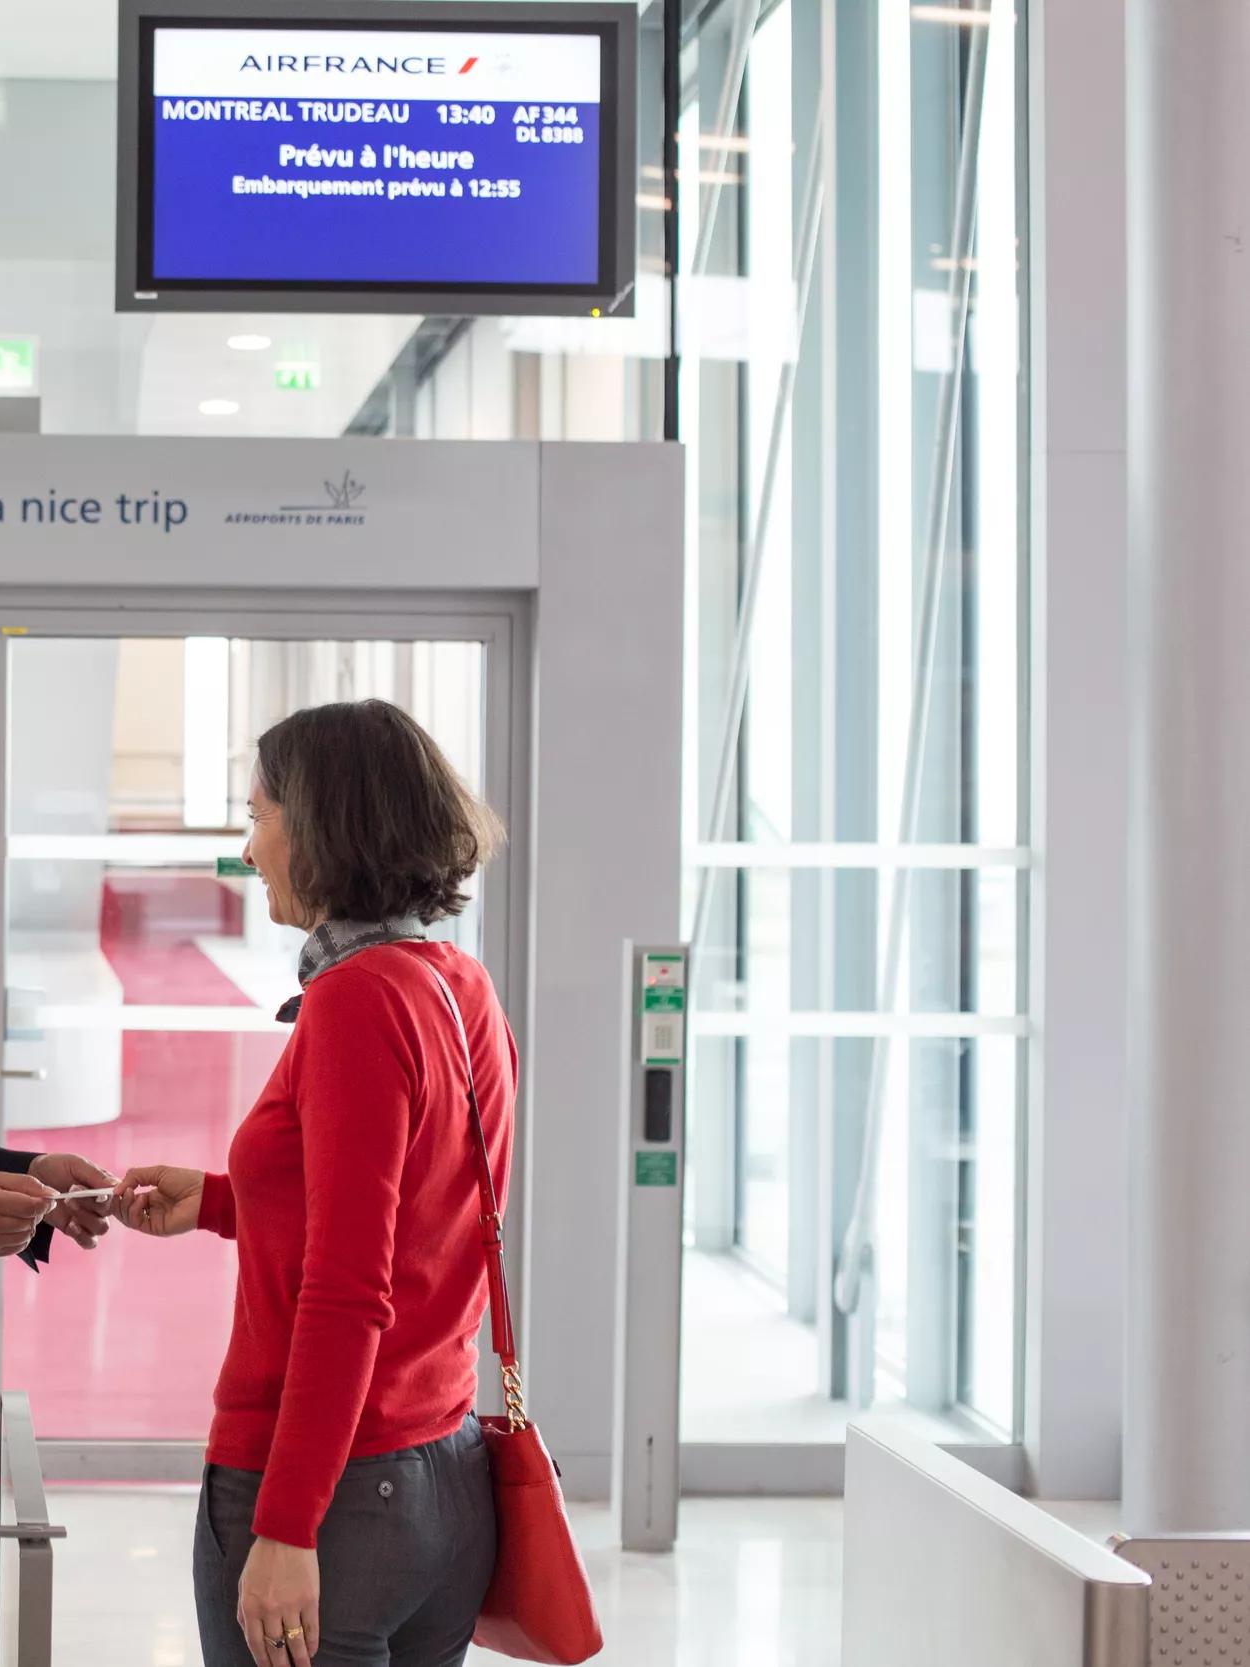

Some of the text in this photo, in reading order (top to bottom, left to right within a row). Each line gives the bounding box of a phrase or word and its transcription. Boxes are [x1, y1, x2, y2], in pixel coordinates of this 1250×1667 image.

[240, 55, 446, 74] AIRFRANCE
[162, 99, 579, 125] MONTREAL TRUDEAU 13:40 AF 344
[515, 126, 540, 143] DL
[279, 143, 475, 170] Prévu à l'heure
[232, 175, 522, 202] Embarquement prévu à 12:55
[21, 490, 101, 524] nice
[117, 491, 188, 533] trip
[306, 514, 322, 526] DE
[327, 514, 366, 526] PARIS
